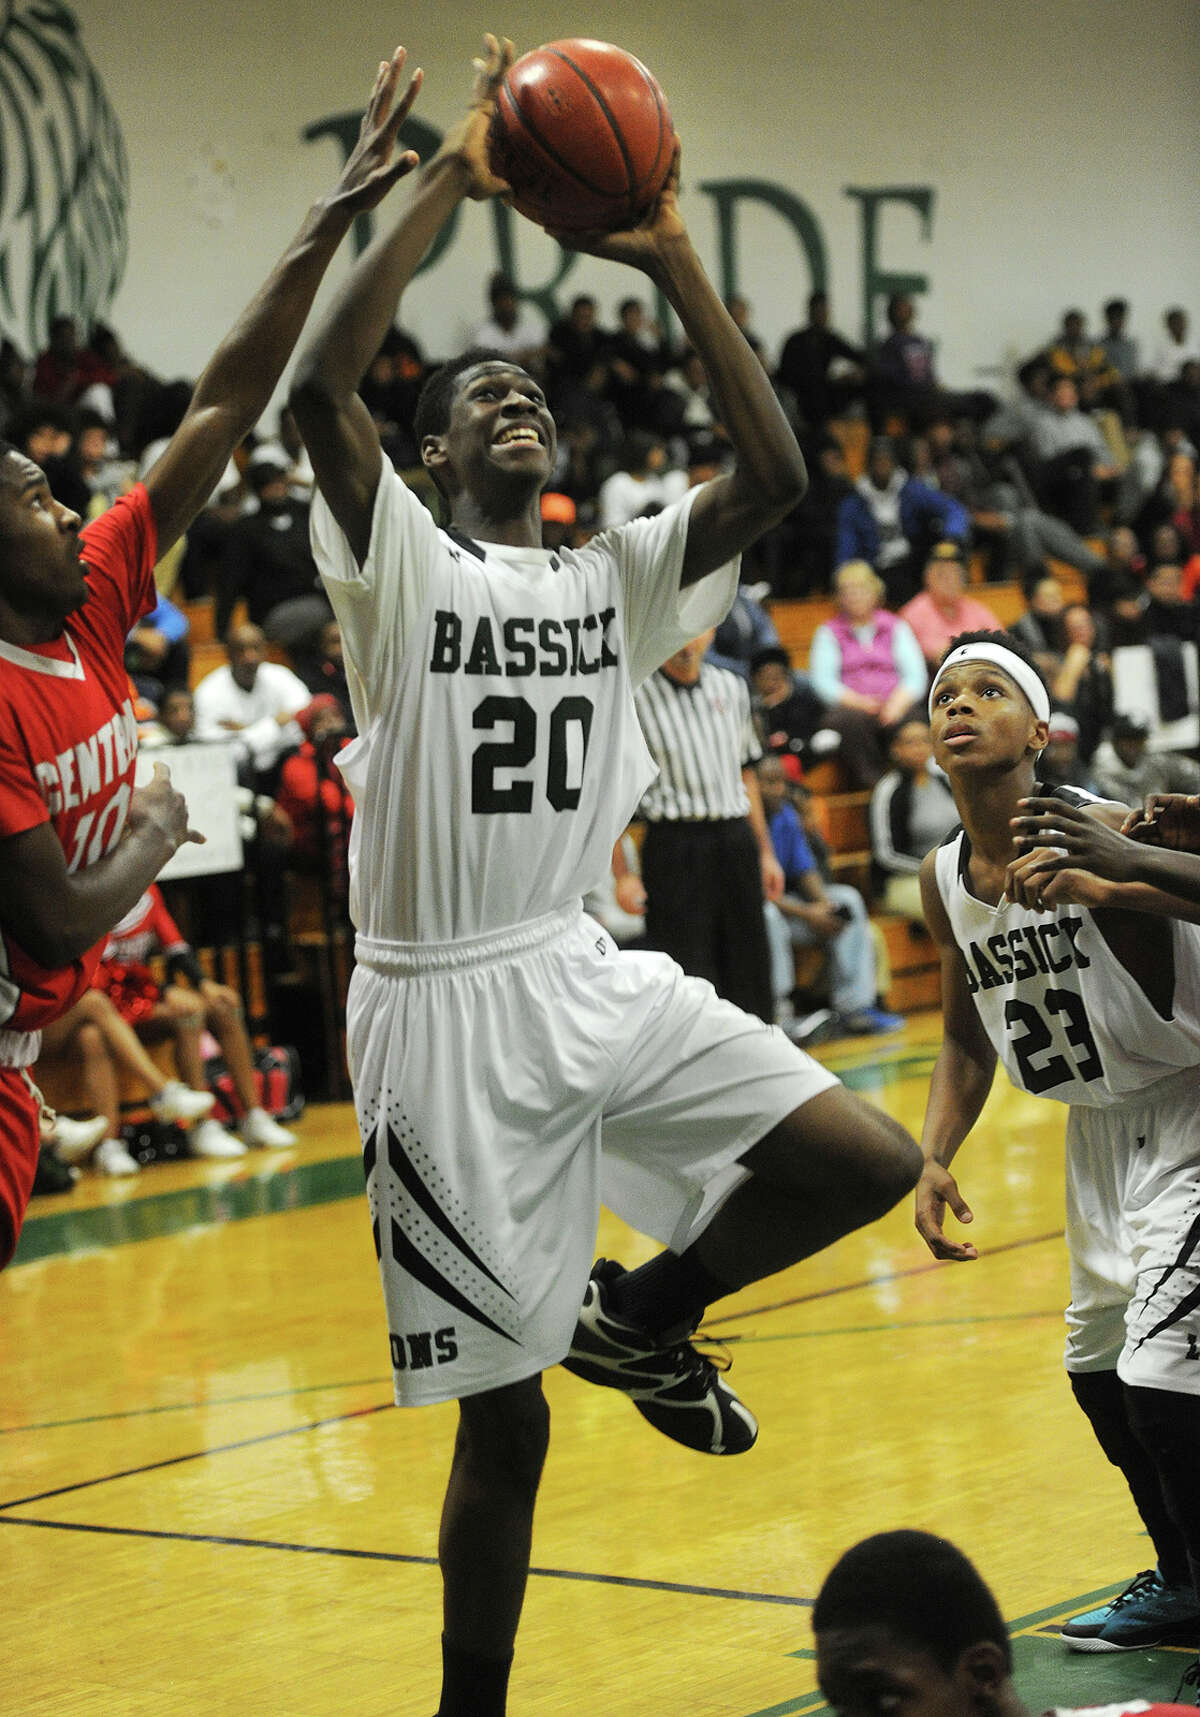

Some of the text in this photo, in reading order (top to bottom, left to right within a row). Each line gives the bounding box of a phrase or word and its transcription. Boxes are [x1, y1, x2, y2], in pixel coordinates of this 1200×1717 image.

[303, 112, 935, 355] PDE
[430, 607, 618, 677] BASSICK
[471, 695, 594, 814] 20
[66, 782, 131, 876] 10
[1004, 988, 1104, 1095] 23
